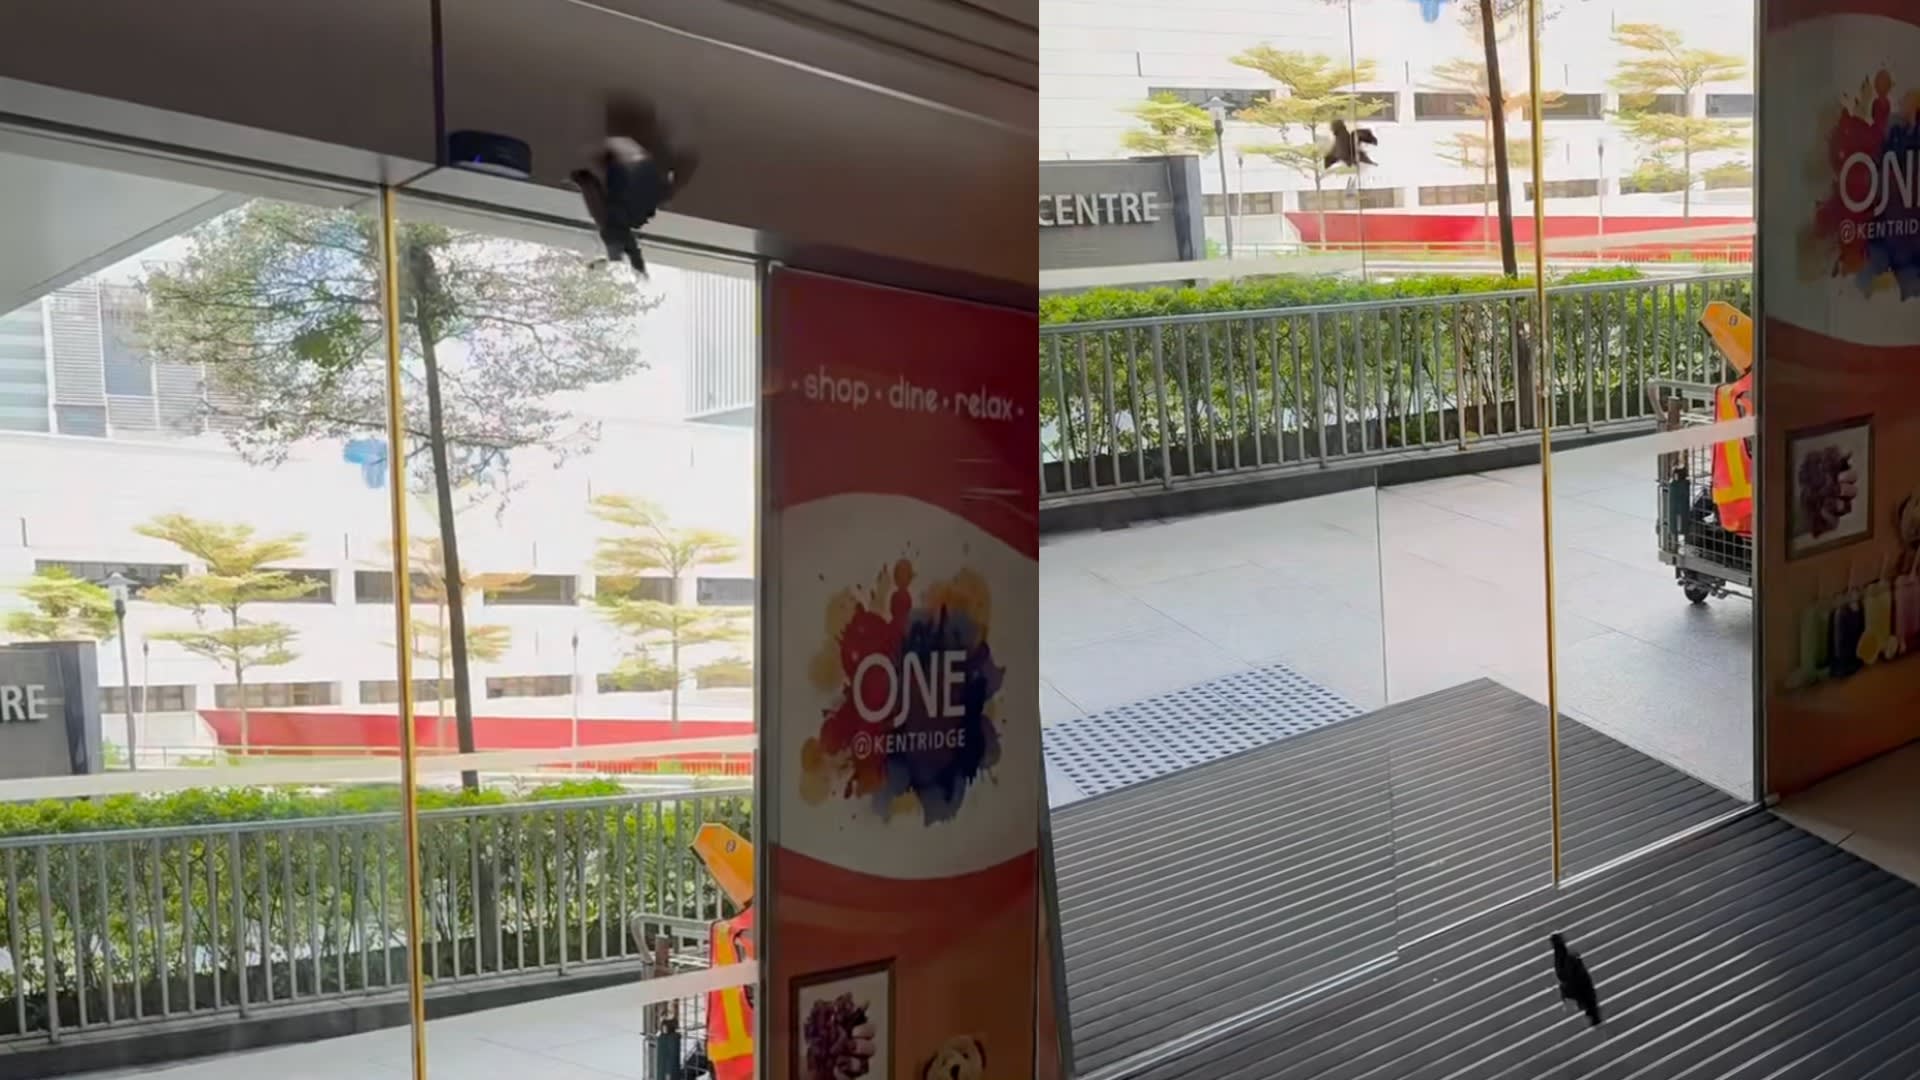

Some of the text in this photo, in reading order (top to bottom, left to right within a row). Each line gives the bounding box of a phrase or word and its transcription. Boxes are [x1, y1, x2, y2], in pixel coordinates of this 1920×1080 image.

[1039, 191, 1161, 226] CENTRE
[1839, 150, 1920, 216] ON
[804, 364, 1014, 421] shop dine relax
[853, 650, 968, 728] ONE
[854, 728, 967, 759] @KENTRIDGE
